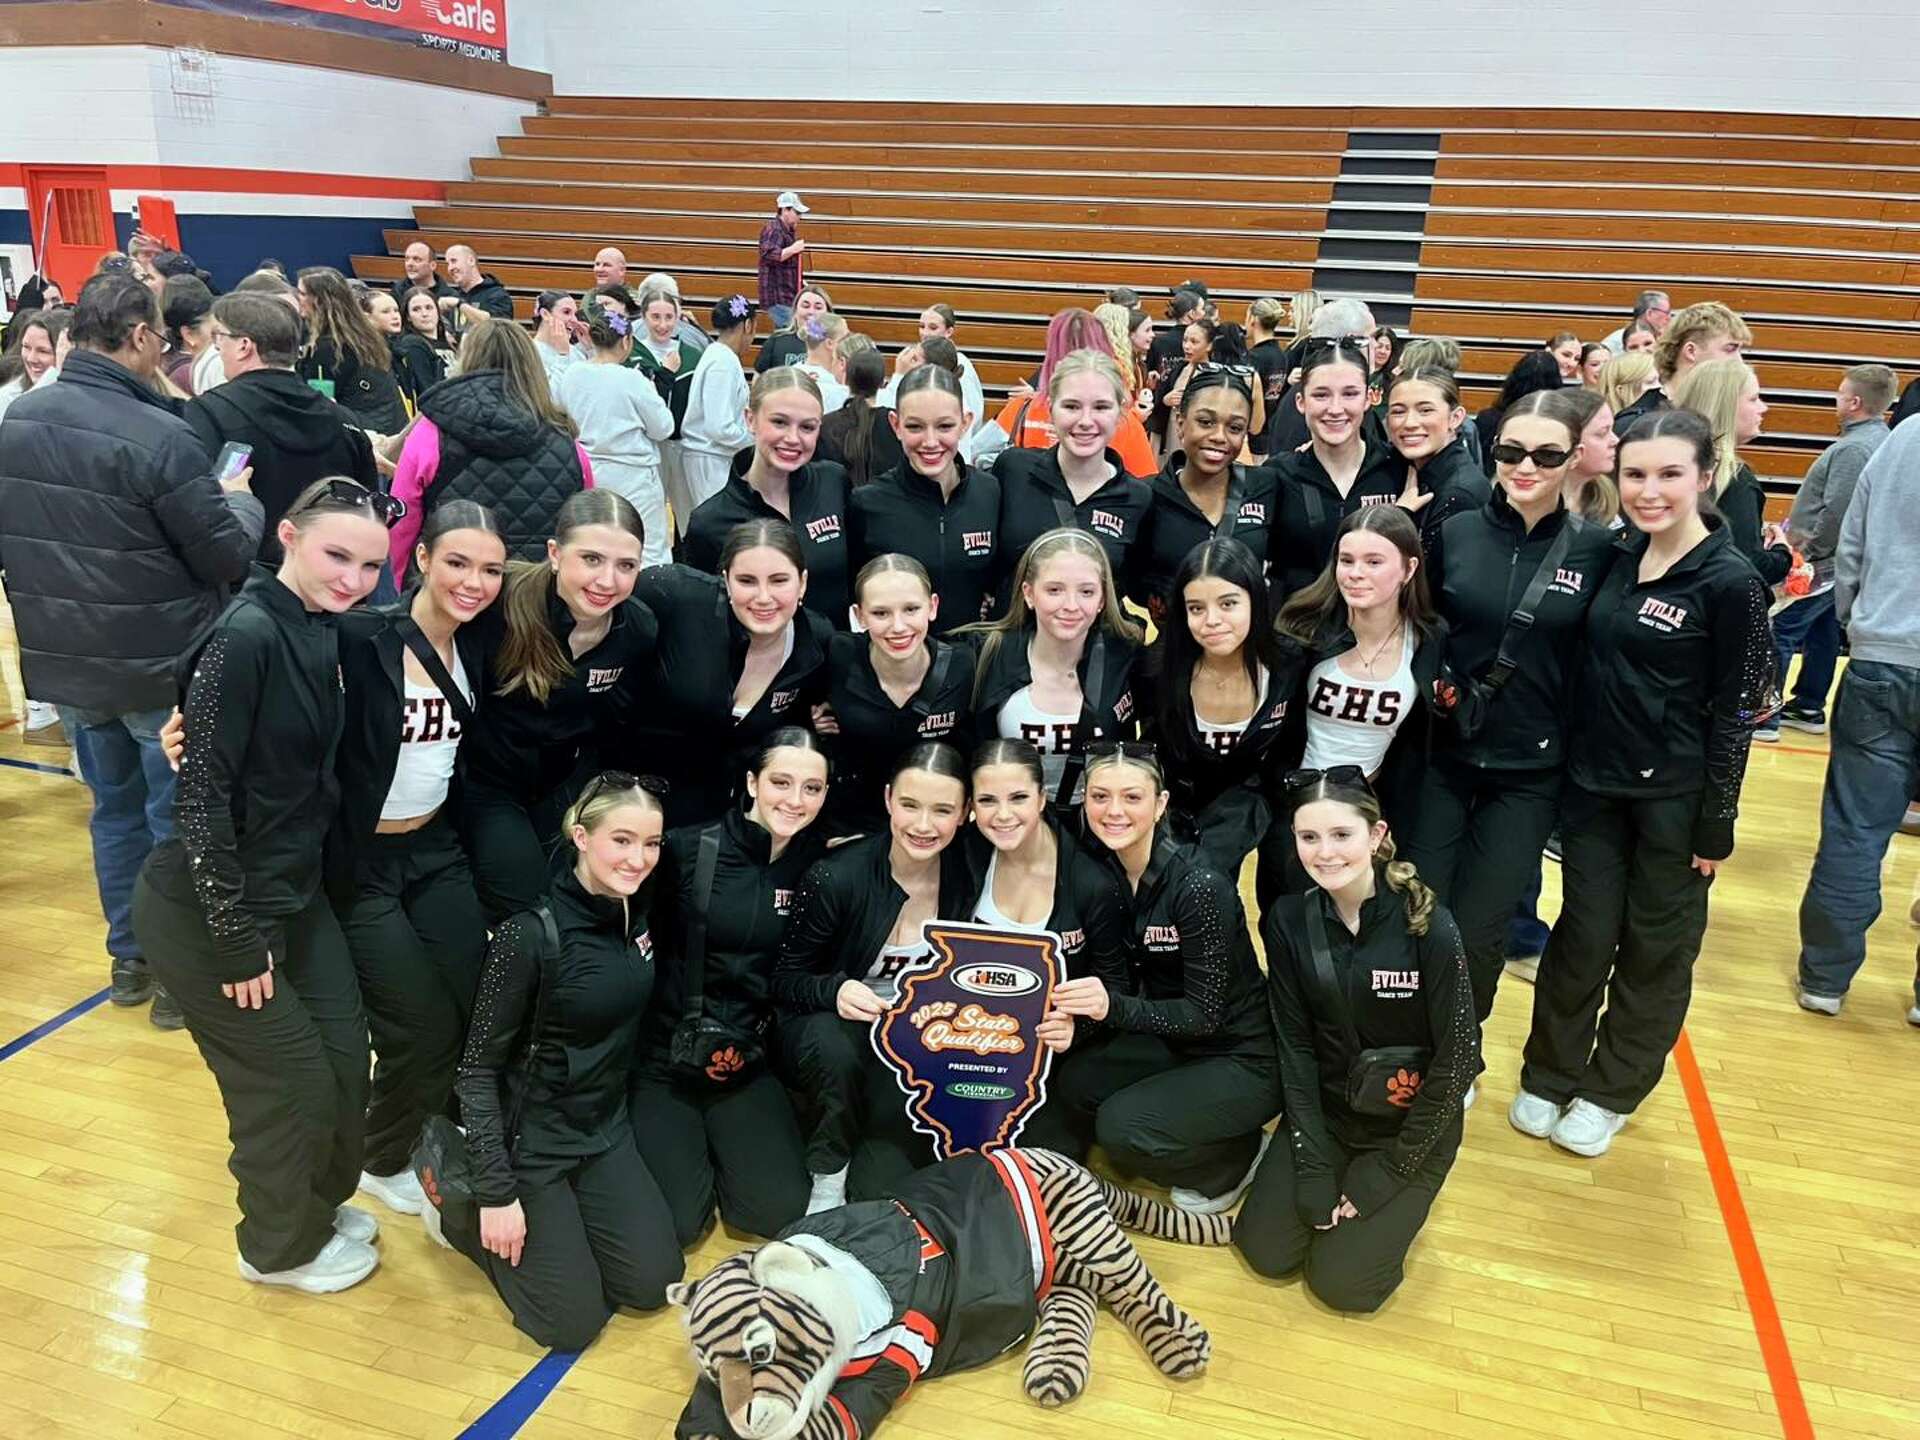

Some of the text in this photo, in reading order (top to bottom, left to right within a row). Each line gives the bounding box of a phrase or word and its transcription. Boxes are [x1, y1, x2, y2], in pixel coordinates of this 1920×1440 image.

[421, 34, 502, 62] SPORTS MEDICINE
[1091, 510, 1124, 535] EVILLE
[1638, 597, 1687, 628] EVILLE
[1308, 677, 1401, 726] EHS
[1144, 926, 1180, 945] EVILLE
[1371, 970, 1419, 990] EVILLE
[910, 1000, 1017, 1032] 2025 State
[923, 1022, 1022, 1053] Qualifier
[948, 1062, 1009, 1074] PRESENTED BY
[954, 1083, 1007, 1095] COUNTRY
